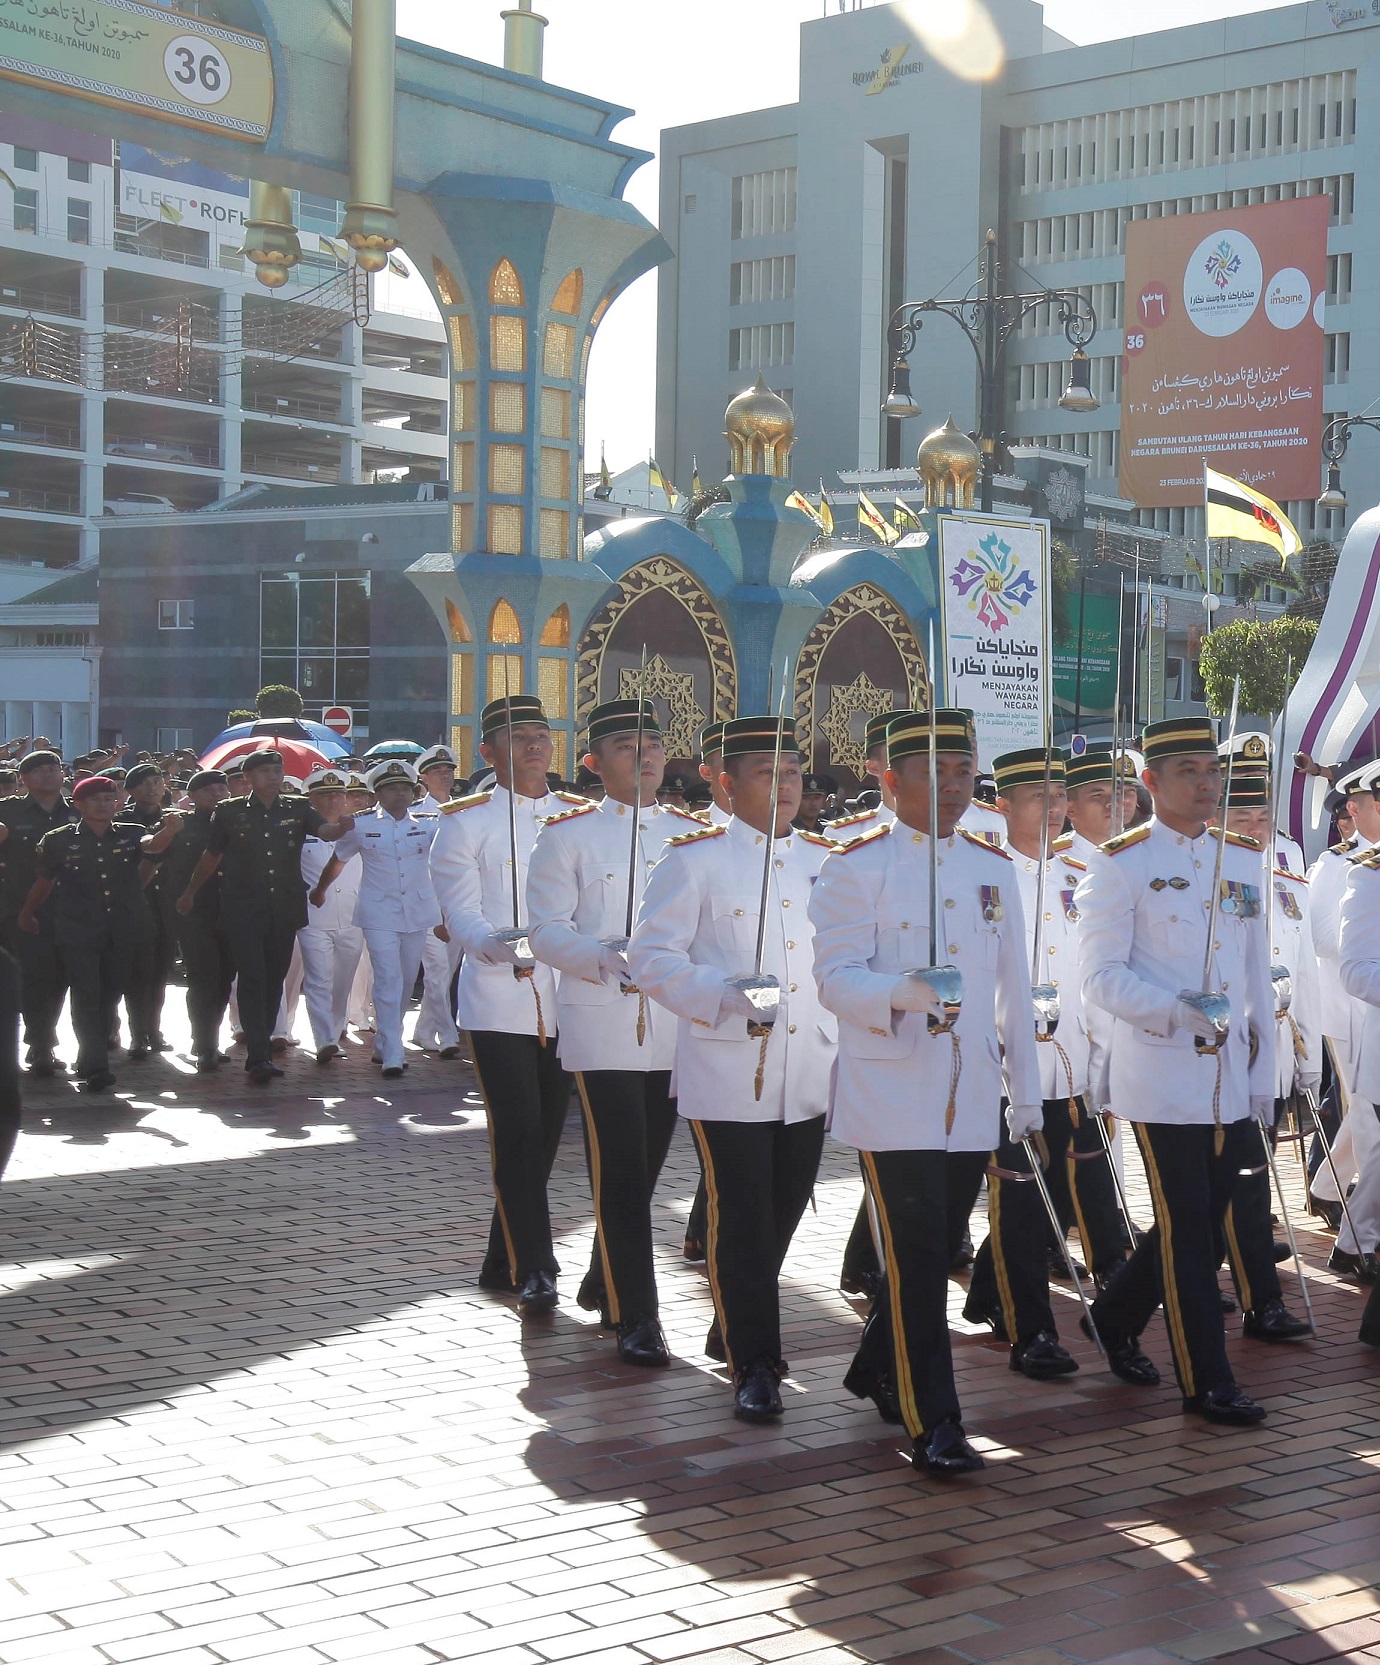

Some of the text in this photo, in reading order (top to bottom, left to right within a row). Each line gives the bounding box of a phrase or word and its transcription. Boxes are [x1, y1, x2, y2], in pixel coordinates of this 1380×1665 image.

[102, 46, 121, 60] 2020
[174, 47, 221, 91] 36
[852, 69, 880, 85] ROYAL
[1270, 294, 1303, 305] imagine
[1126, 334, 1145, 349] 36
[1138, 427, 1299, 446] SAMBUTAN ULANG TAHUN HARI KEBANGSAAN
[1131, 437, 1309, 457] NEGARA BRUNEI DARUSSALAM KE-36, TAHUN 2020
[1159, 479, 1167, 487] 23
[1167, 477, 1195, 486] FEBRUARI
[981, 681, 1038, 692] MENJAYAKAN
[995, 691, 1038, 701] WAWASAN
[1004, 701, 1038, 710] NEGARA
